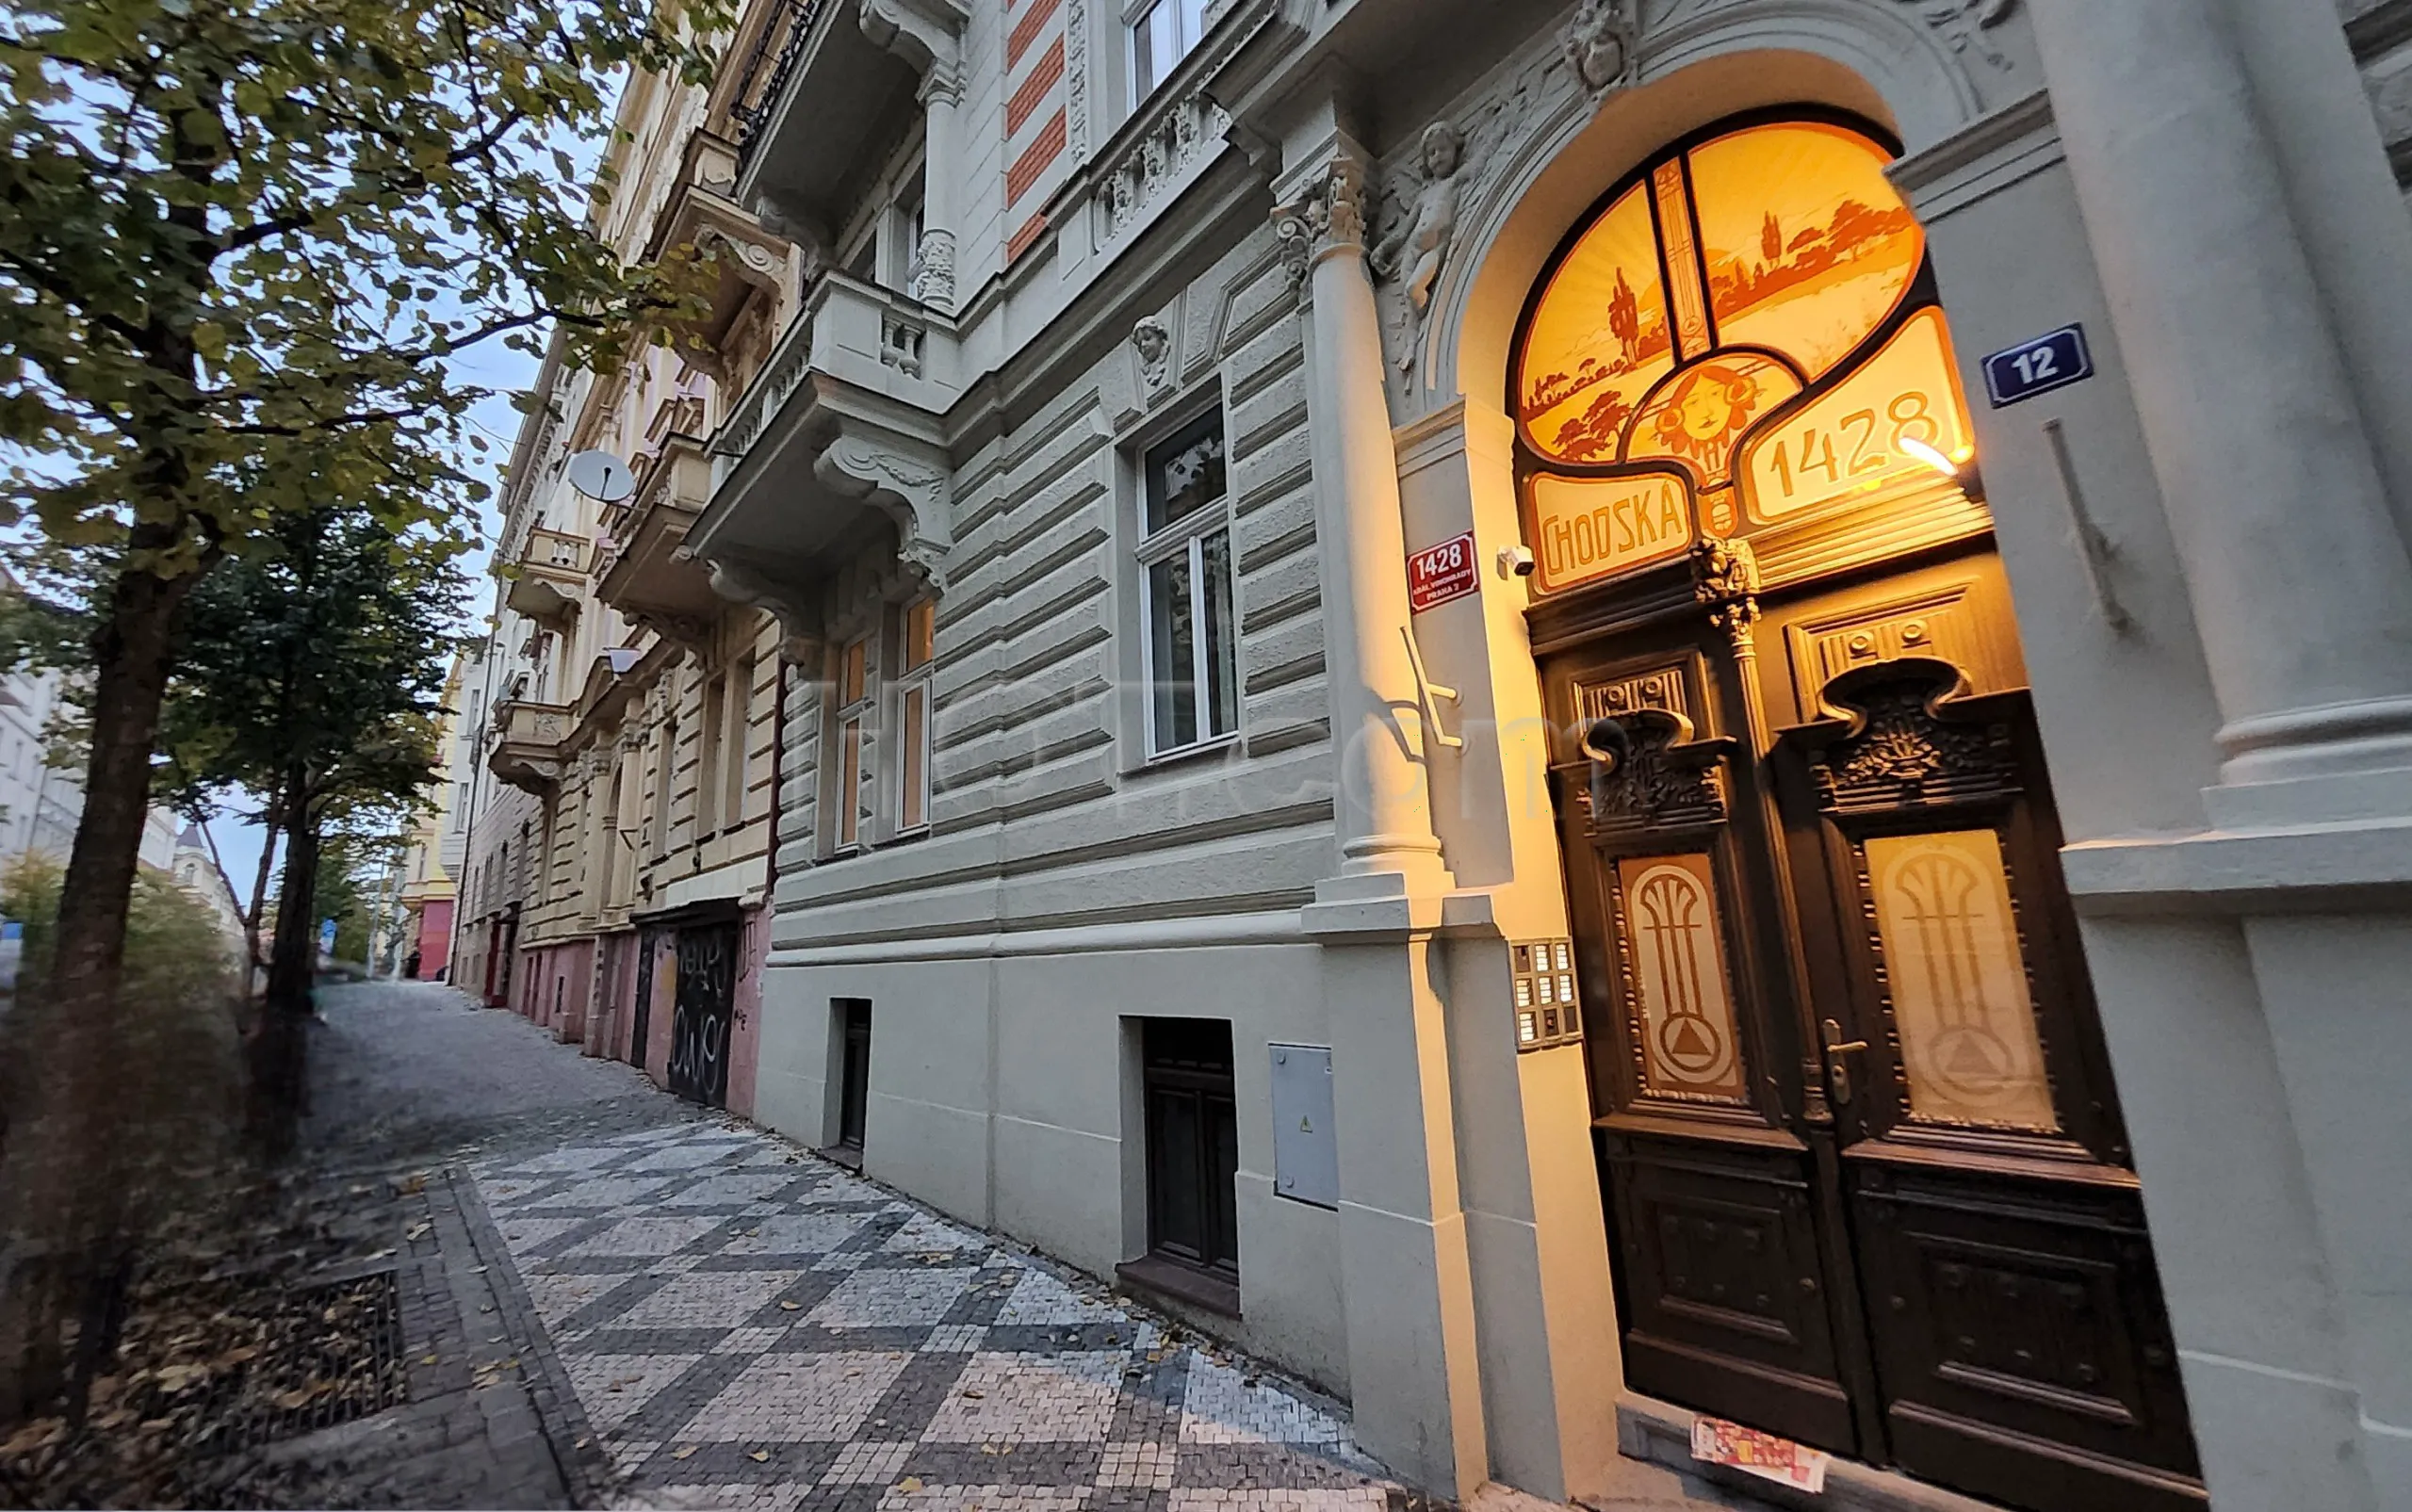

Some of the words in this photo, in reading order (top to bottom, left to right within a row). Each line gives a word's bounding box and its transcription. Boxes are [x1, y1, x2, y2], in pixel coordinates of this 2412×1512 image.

[2011, 346, 2060, 384] 12
[1769, 391, 1939, 498] 1428
[1416, 544, 1462, 580] 1428
[1426, 586, 1453, 601] PRAHA
